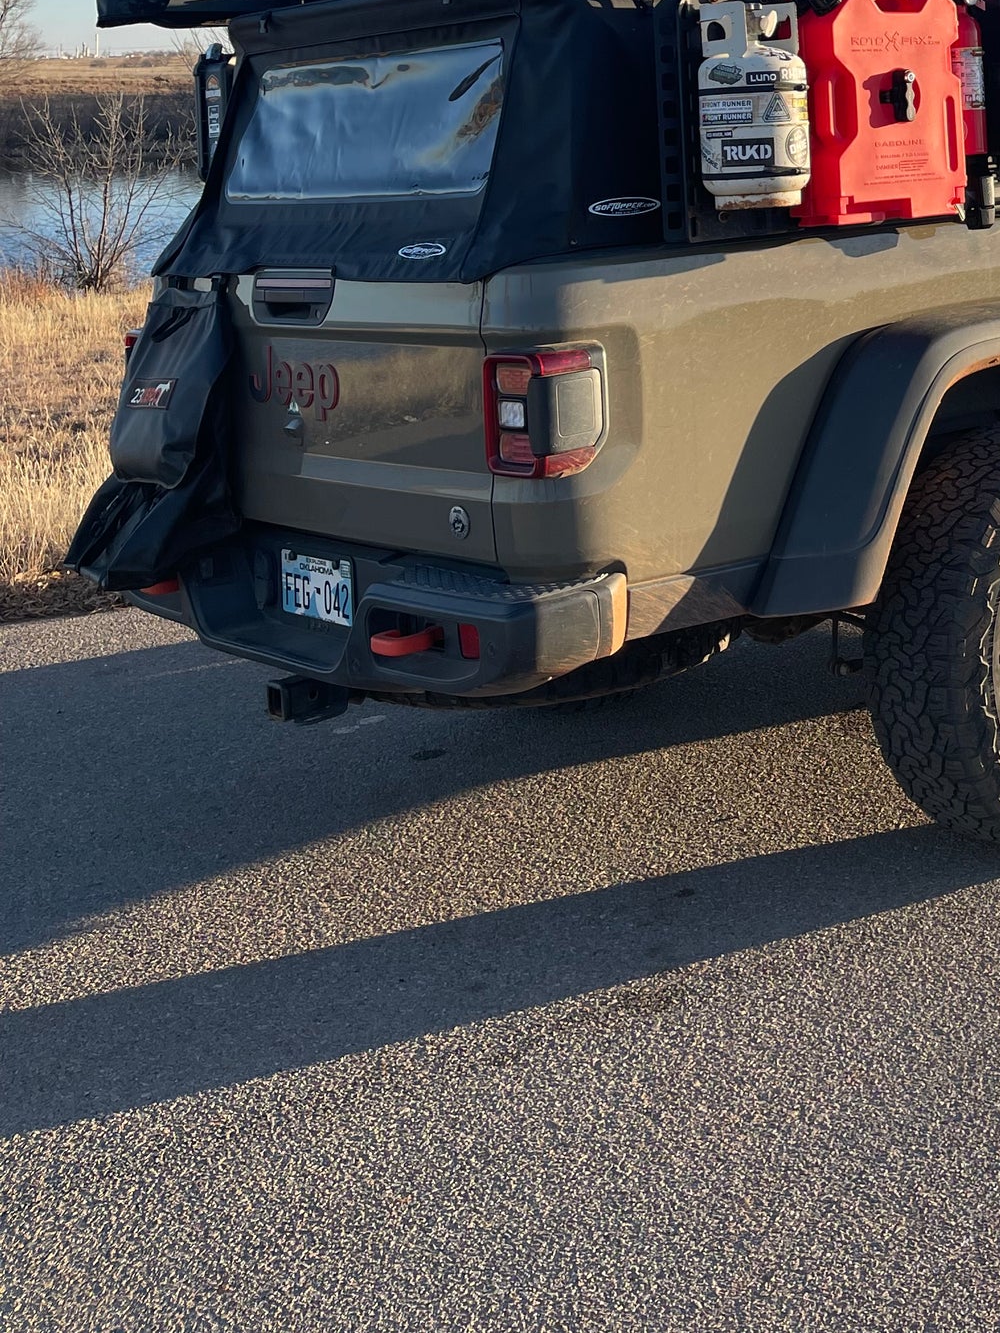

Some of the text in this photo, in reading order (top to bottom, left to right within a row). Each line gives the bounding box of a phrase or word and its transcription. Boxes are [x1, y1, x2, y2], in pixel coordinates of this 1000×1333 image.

[722, 100, 752, 108] RUNNER
[722, 112, 752, 120] RUNNER
[249, 346, 340, 422] Jeep
[299, 562, 334, 576] OKLAHOMA
